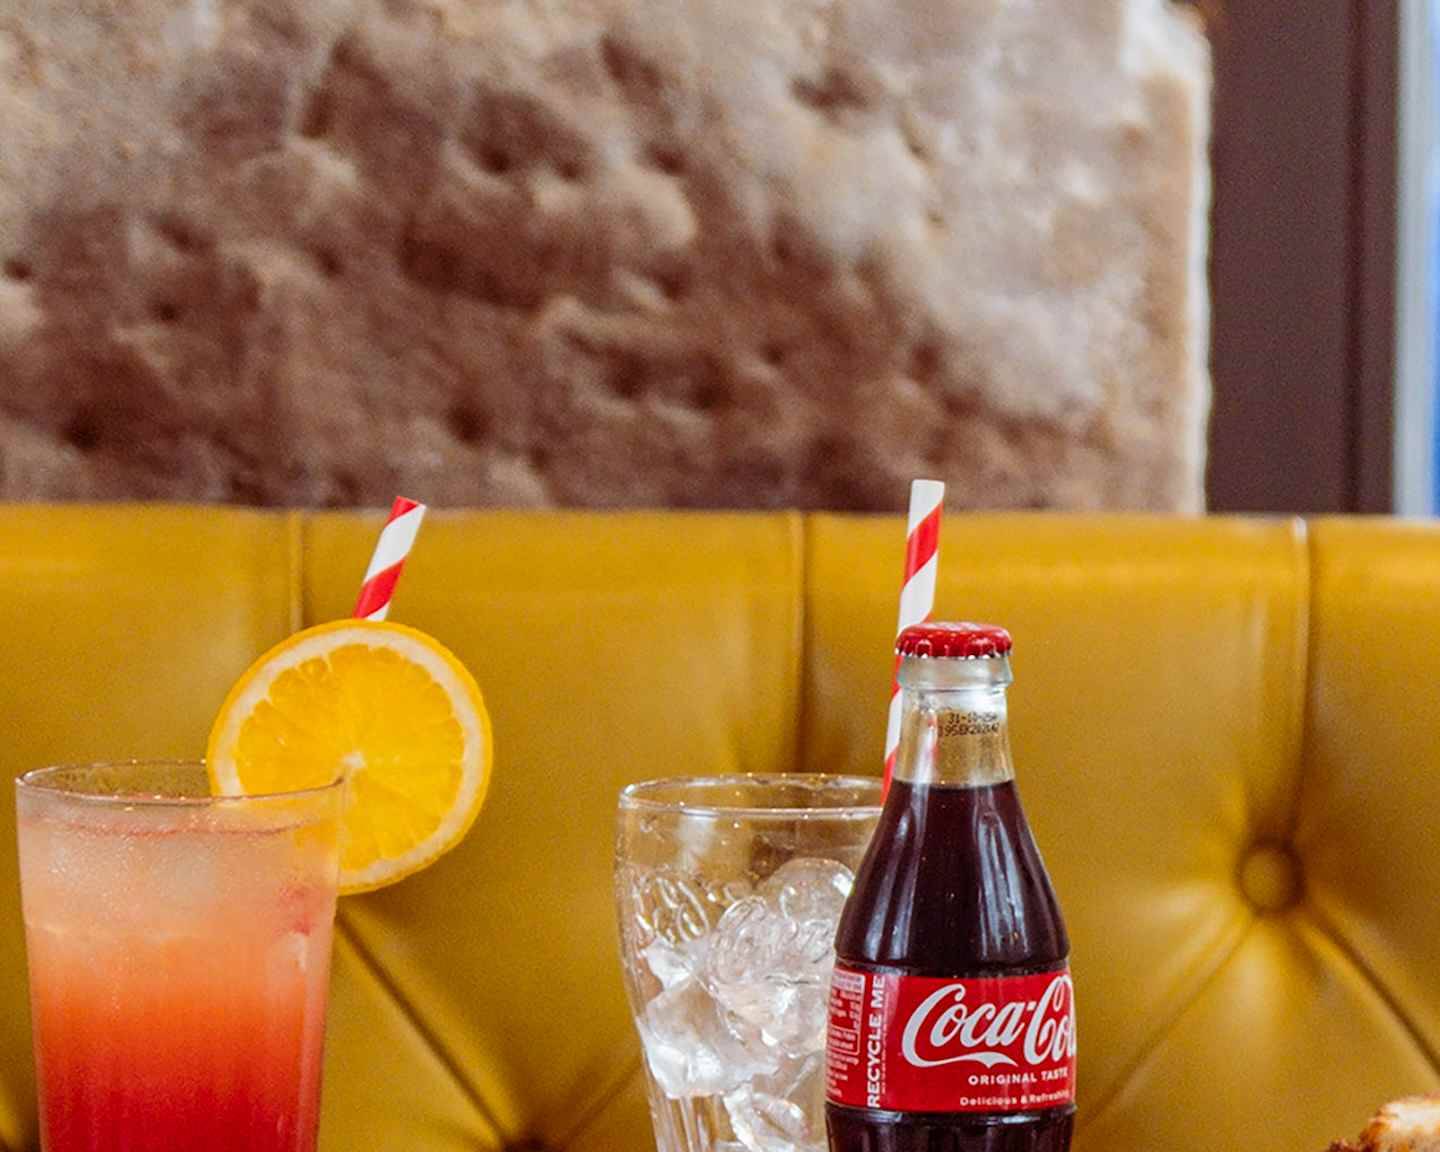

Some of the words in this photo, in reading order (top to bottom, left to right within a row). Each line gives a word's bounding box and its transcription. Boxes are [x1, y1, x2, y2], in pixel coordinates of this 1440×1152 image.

[871, 975, 886, 1008] ME
[867, 1014, 881, 1108] RECYCLE
[967, 1072, 1037, 1086] ORIGINAL
[1040, 1066, 1068, 1081] TASTE
[959, 1096, 1018, 1106] Delicious
